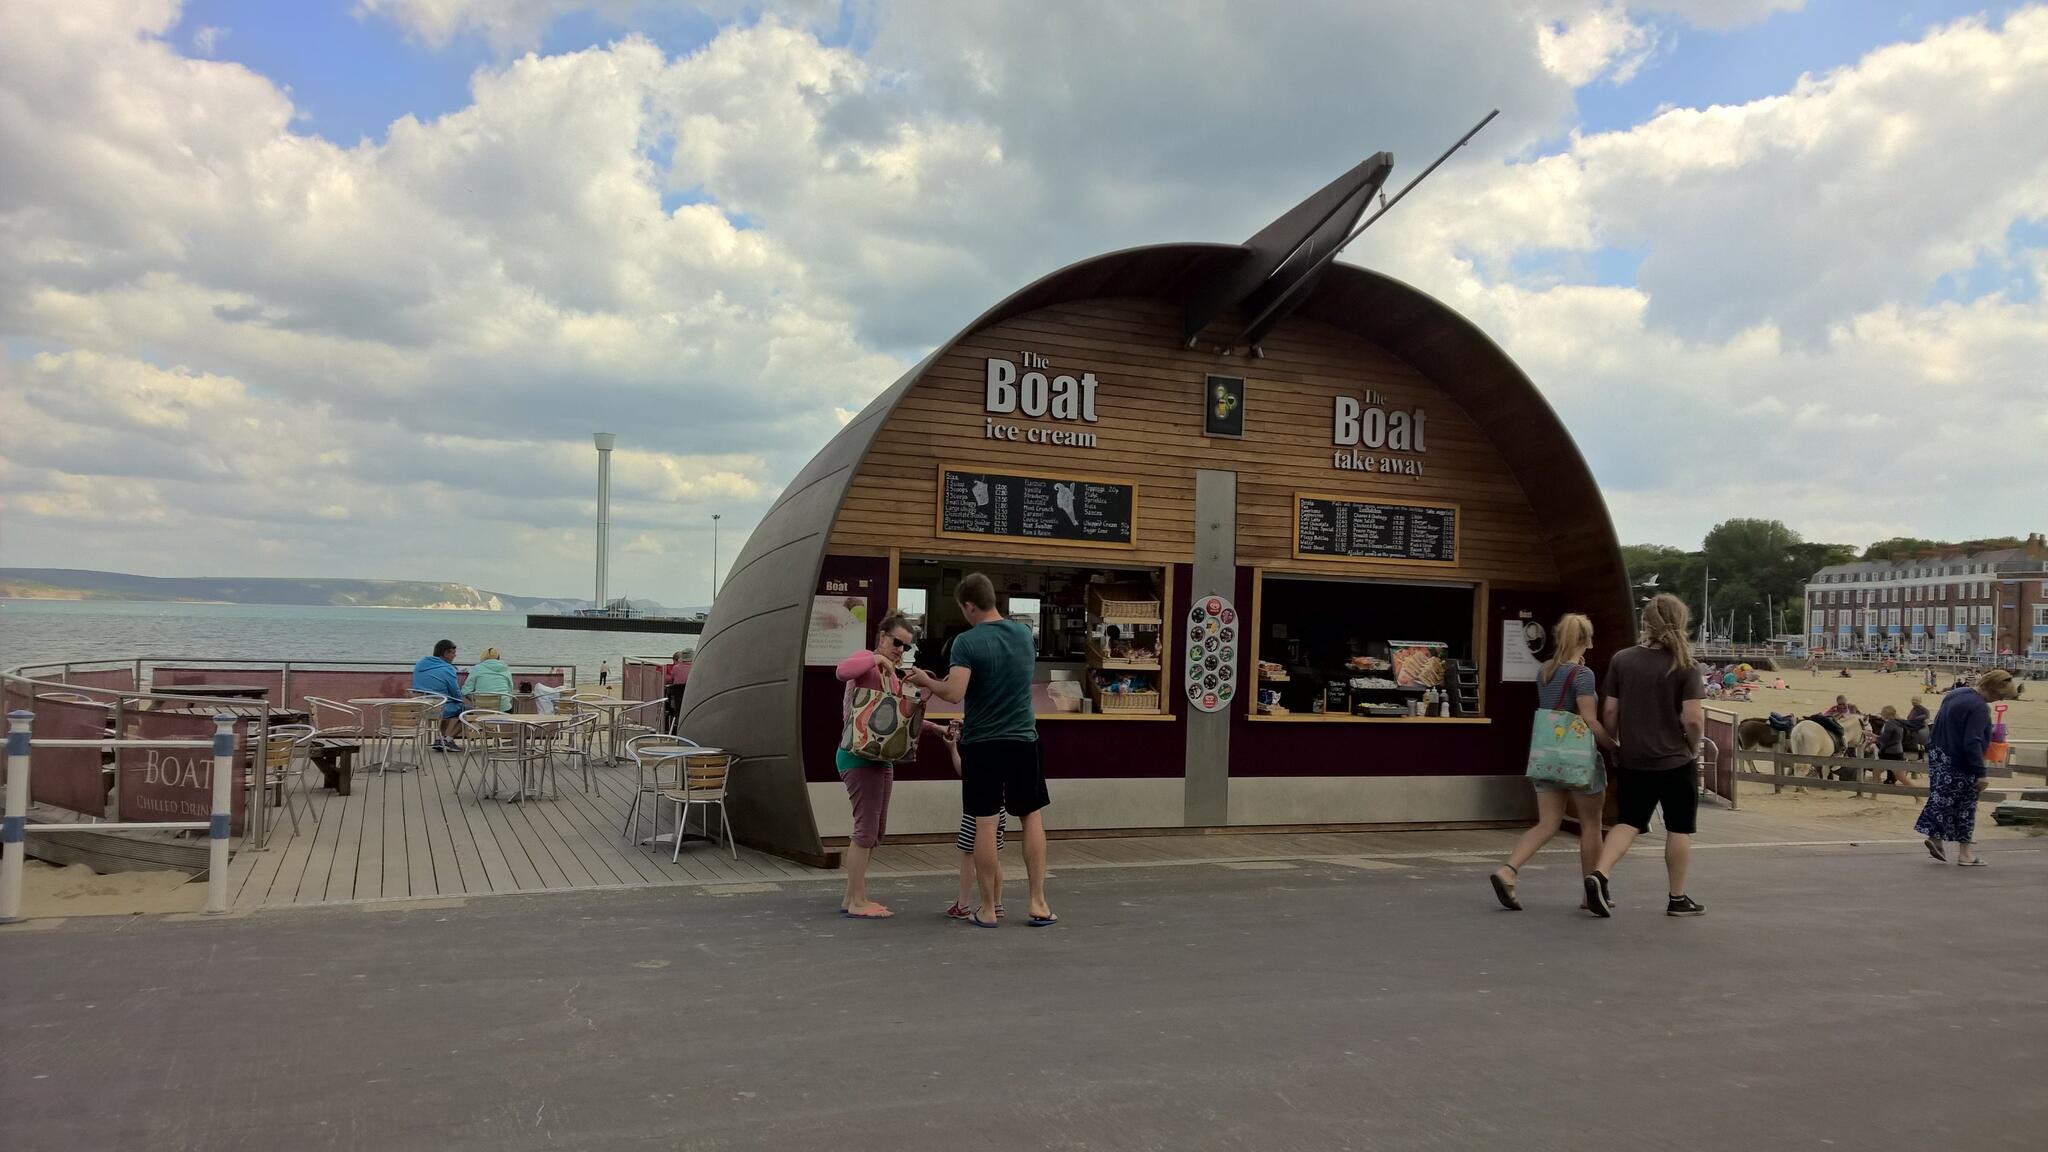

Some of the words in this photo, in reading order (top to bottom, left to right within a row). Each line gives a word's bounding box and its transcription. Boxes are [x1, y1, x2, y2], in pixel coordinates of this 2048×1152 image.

[1021, 351, 1049, 369] The
[987, 359, 1098, 421] Boat
[1362, 389, 1387, 405] The
[986, 417, 1019, 440] ice
[1028, 428, 1096, 447] cream
[1335, 396, 1426, 452] Boat
[1334, 450, 1374, 471] take
[1381, 458, 1424, 480] away
[826, 582, 848, 591] Boat
[144, 750, 214, 789] BOAT
[137, 795, 177, 813] CHILLED
[181, 800, 214, 816] DRIN
